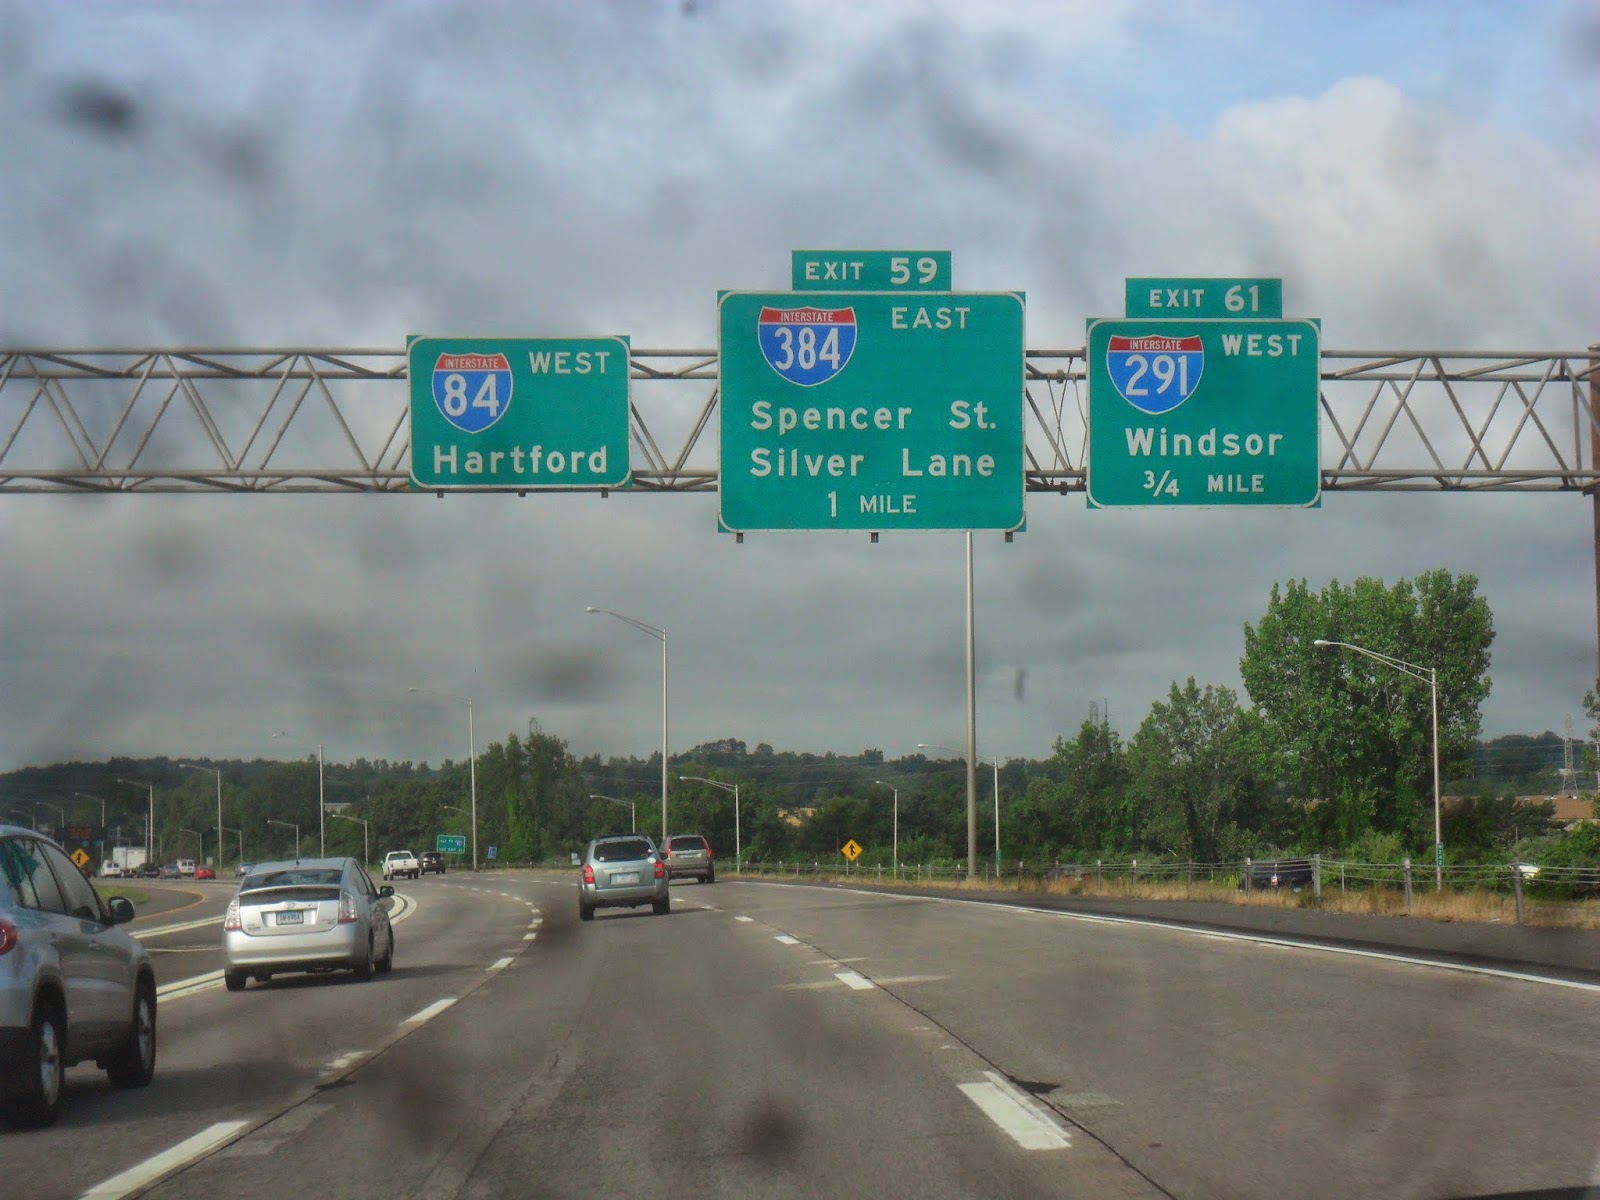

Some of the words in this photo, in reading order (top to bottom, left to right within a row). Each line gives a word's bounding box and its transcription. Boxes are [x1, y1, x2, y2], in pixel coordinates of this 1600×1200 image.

[805, 261, 864, 281] EXIT
[890, 257, 938, 285] 59
[1149, 288, 1205, 308] EXIT
[1224, 285, 1259, 312] 61
[780, 311, 833, 323] INTERSTATE
[891, 306, 971, 330] EAST
[775, 327, 840, 370] 384
[1129, 339, 1182, 350] INTERSTATE
[1222, 334, 1302, 357] WEST
[445, 358, 499, 369] INTERSTATE
[528, 351, 611, 375] WEST
[1125, 354, 1188, 396] 291
[443, 373, 500, 417] 84
[750, 400, 912, 436] Spencer
[949, 400, 997, 430] St.
[1125, 427, 1284, 457] Windsor
[434, 445, 607, 474] Hartford
[750, 447, 864, 477] Silver
[902, 447, 996, 477] Lane
[1207, 474, 1265, 493] MILE
[827, 490, 837, 518] 1
[860, 494, 917, 513] MILE
